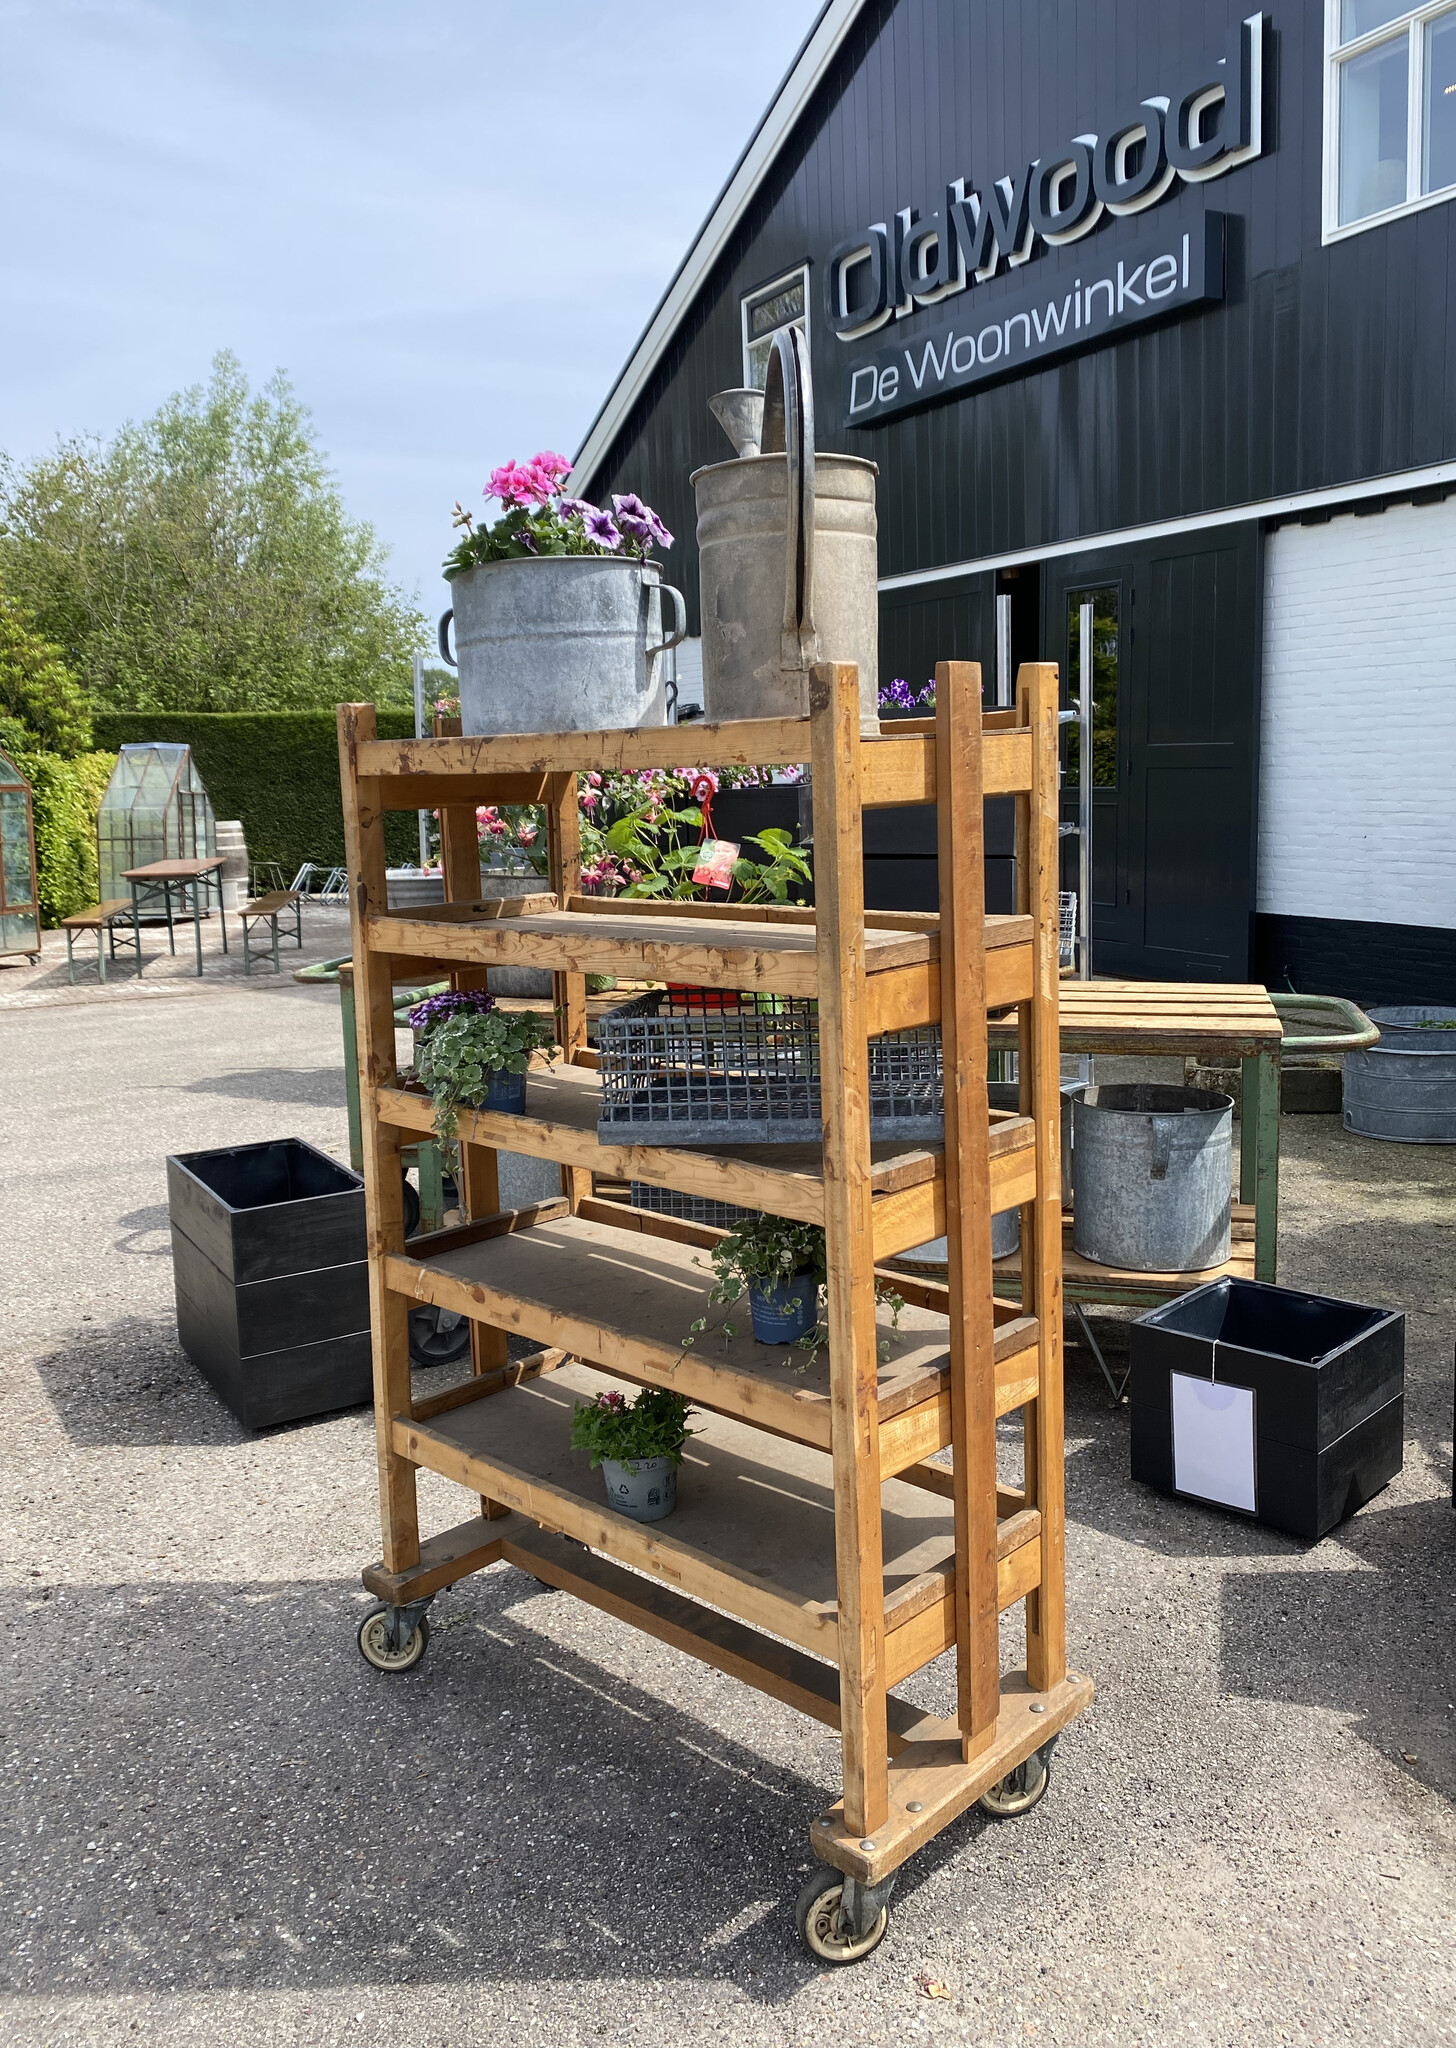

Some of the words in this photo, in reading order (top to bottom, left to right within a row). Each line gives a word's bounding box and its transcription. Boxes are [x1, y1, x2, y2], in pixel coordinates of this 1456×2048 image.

[824, 11, 1262, 340] Oldwood
[850, 365, 899, 414] De
[904, 233, 1189, 389] Woonwinkel
